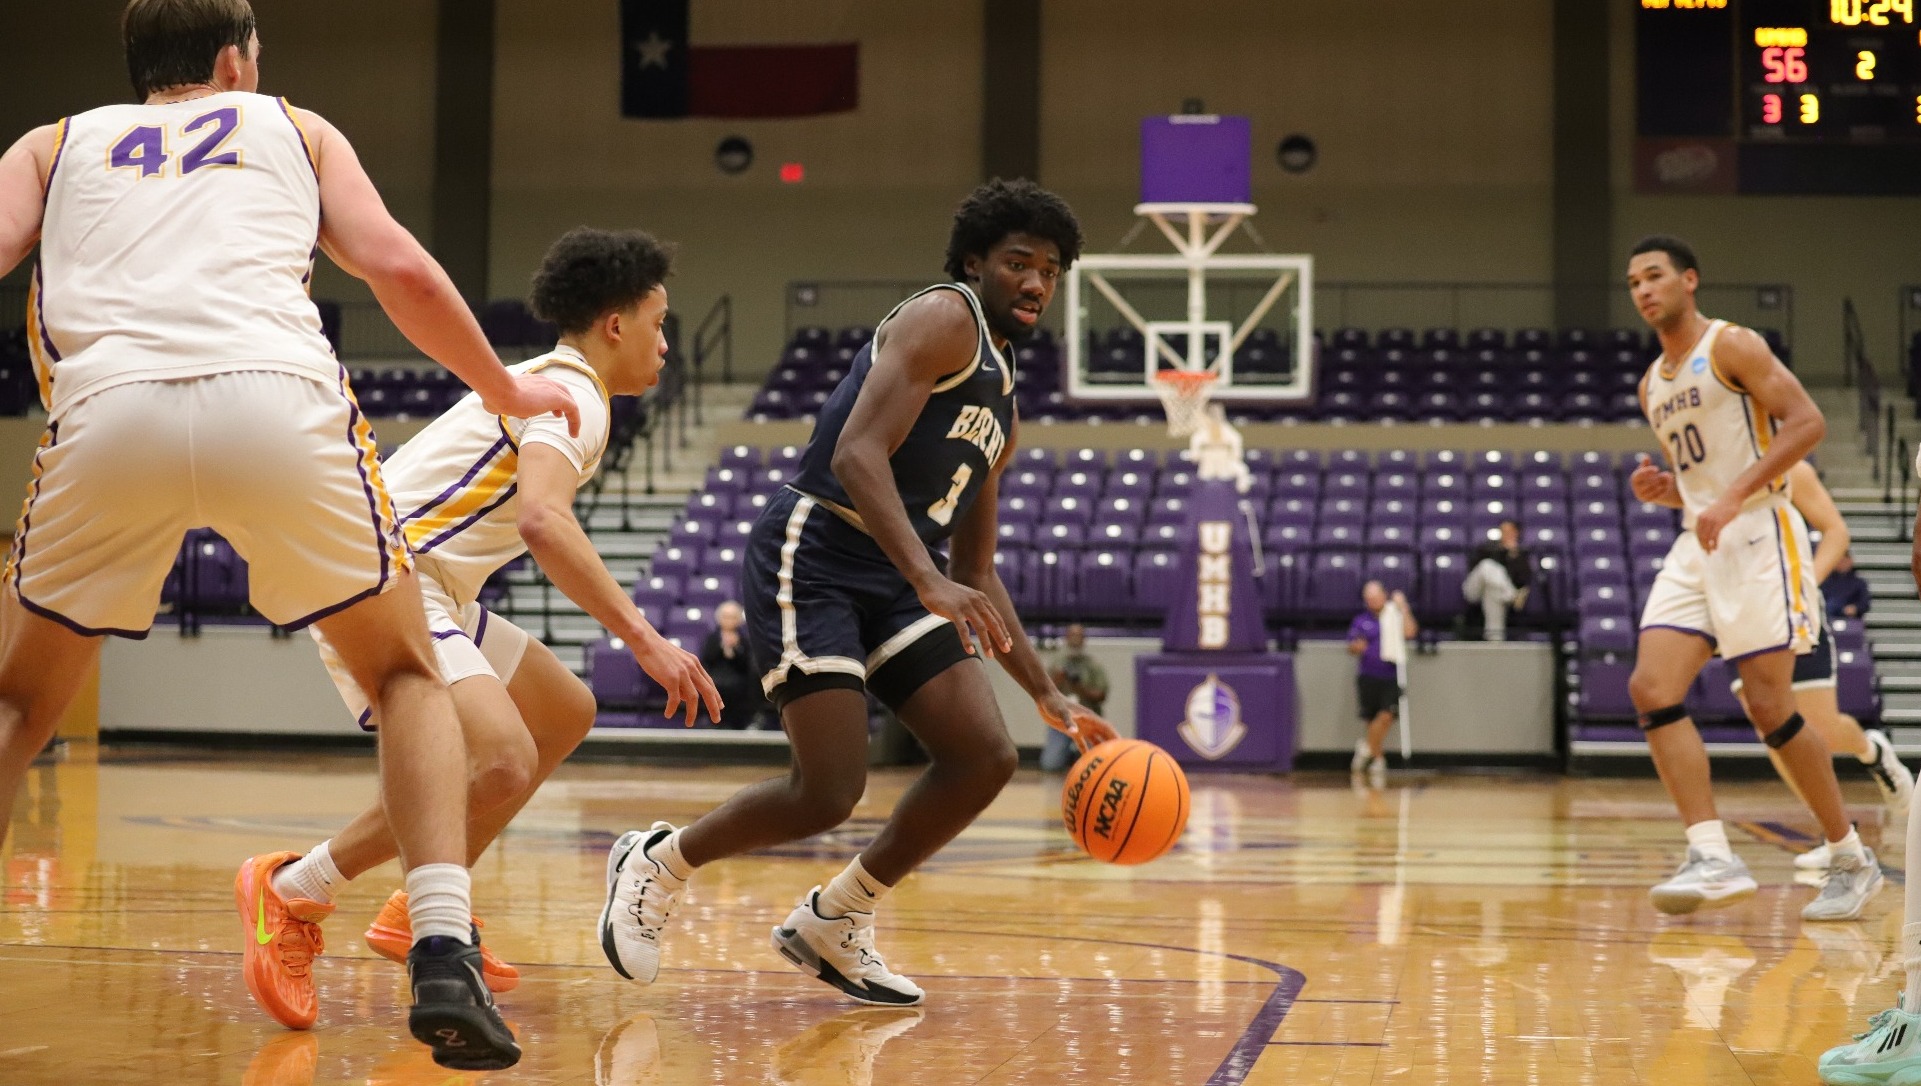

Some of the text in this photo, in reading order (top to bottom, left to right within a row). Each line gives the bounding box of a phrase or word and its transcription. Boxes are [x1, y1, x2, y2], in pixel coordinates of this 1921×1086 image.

[1762, 47, 1807, 83] 56
[1856, 50, 1876, 80] 2
[1763, 94, 1781, 123] 3
[1800, 94, 1819, 123] 3
[105, 104, 244, 181] 42
[1653, 385, 1701, 430] UMHB
[1669, 423, 1706, 472] 20
[927, 462, 973, 527] 3
[1198, 520, 1232, 649] UMHB
[1064, 756, 1103, 834] Wilson
[1093, 777, 1128, 840] NCAA
